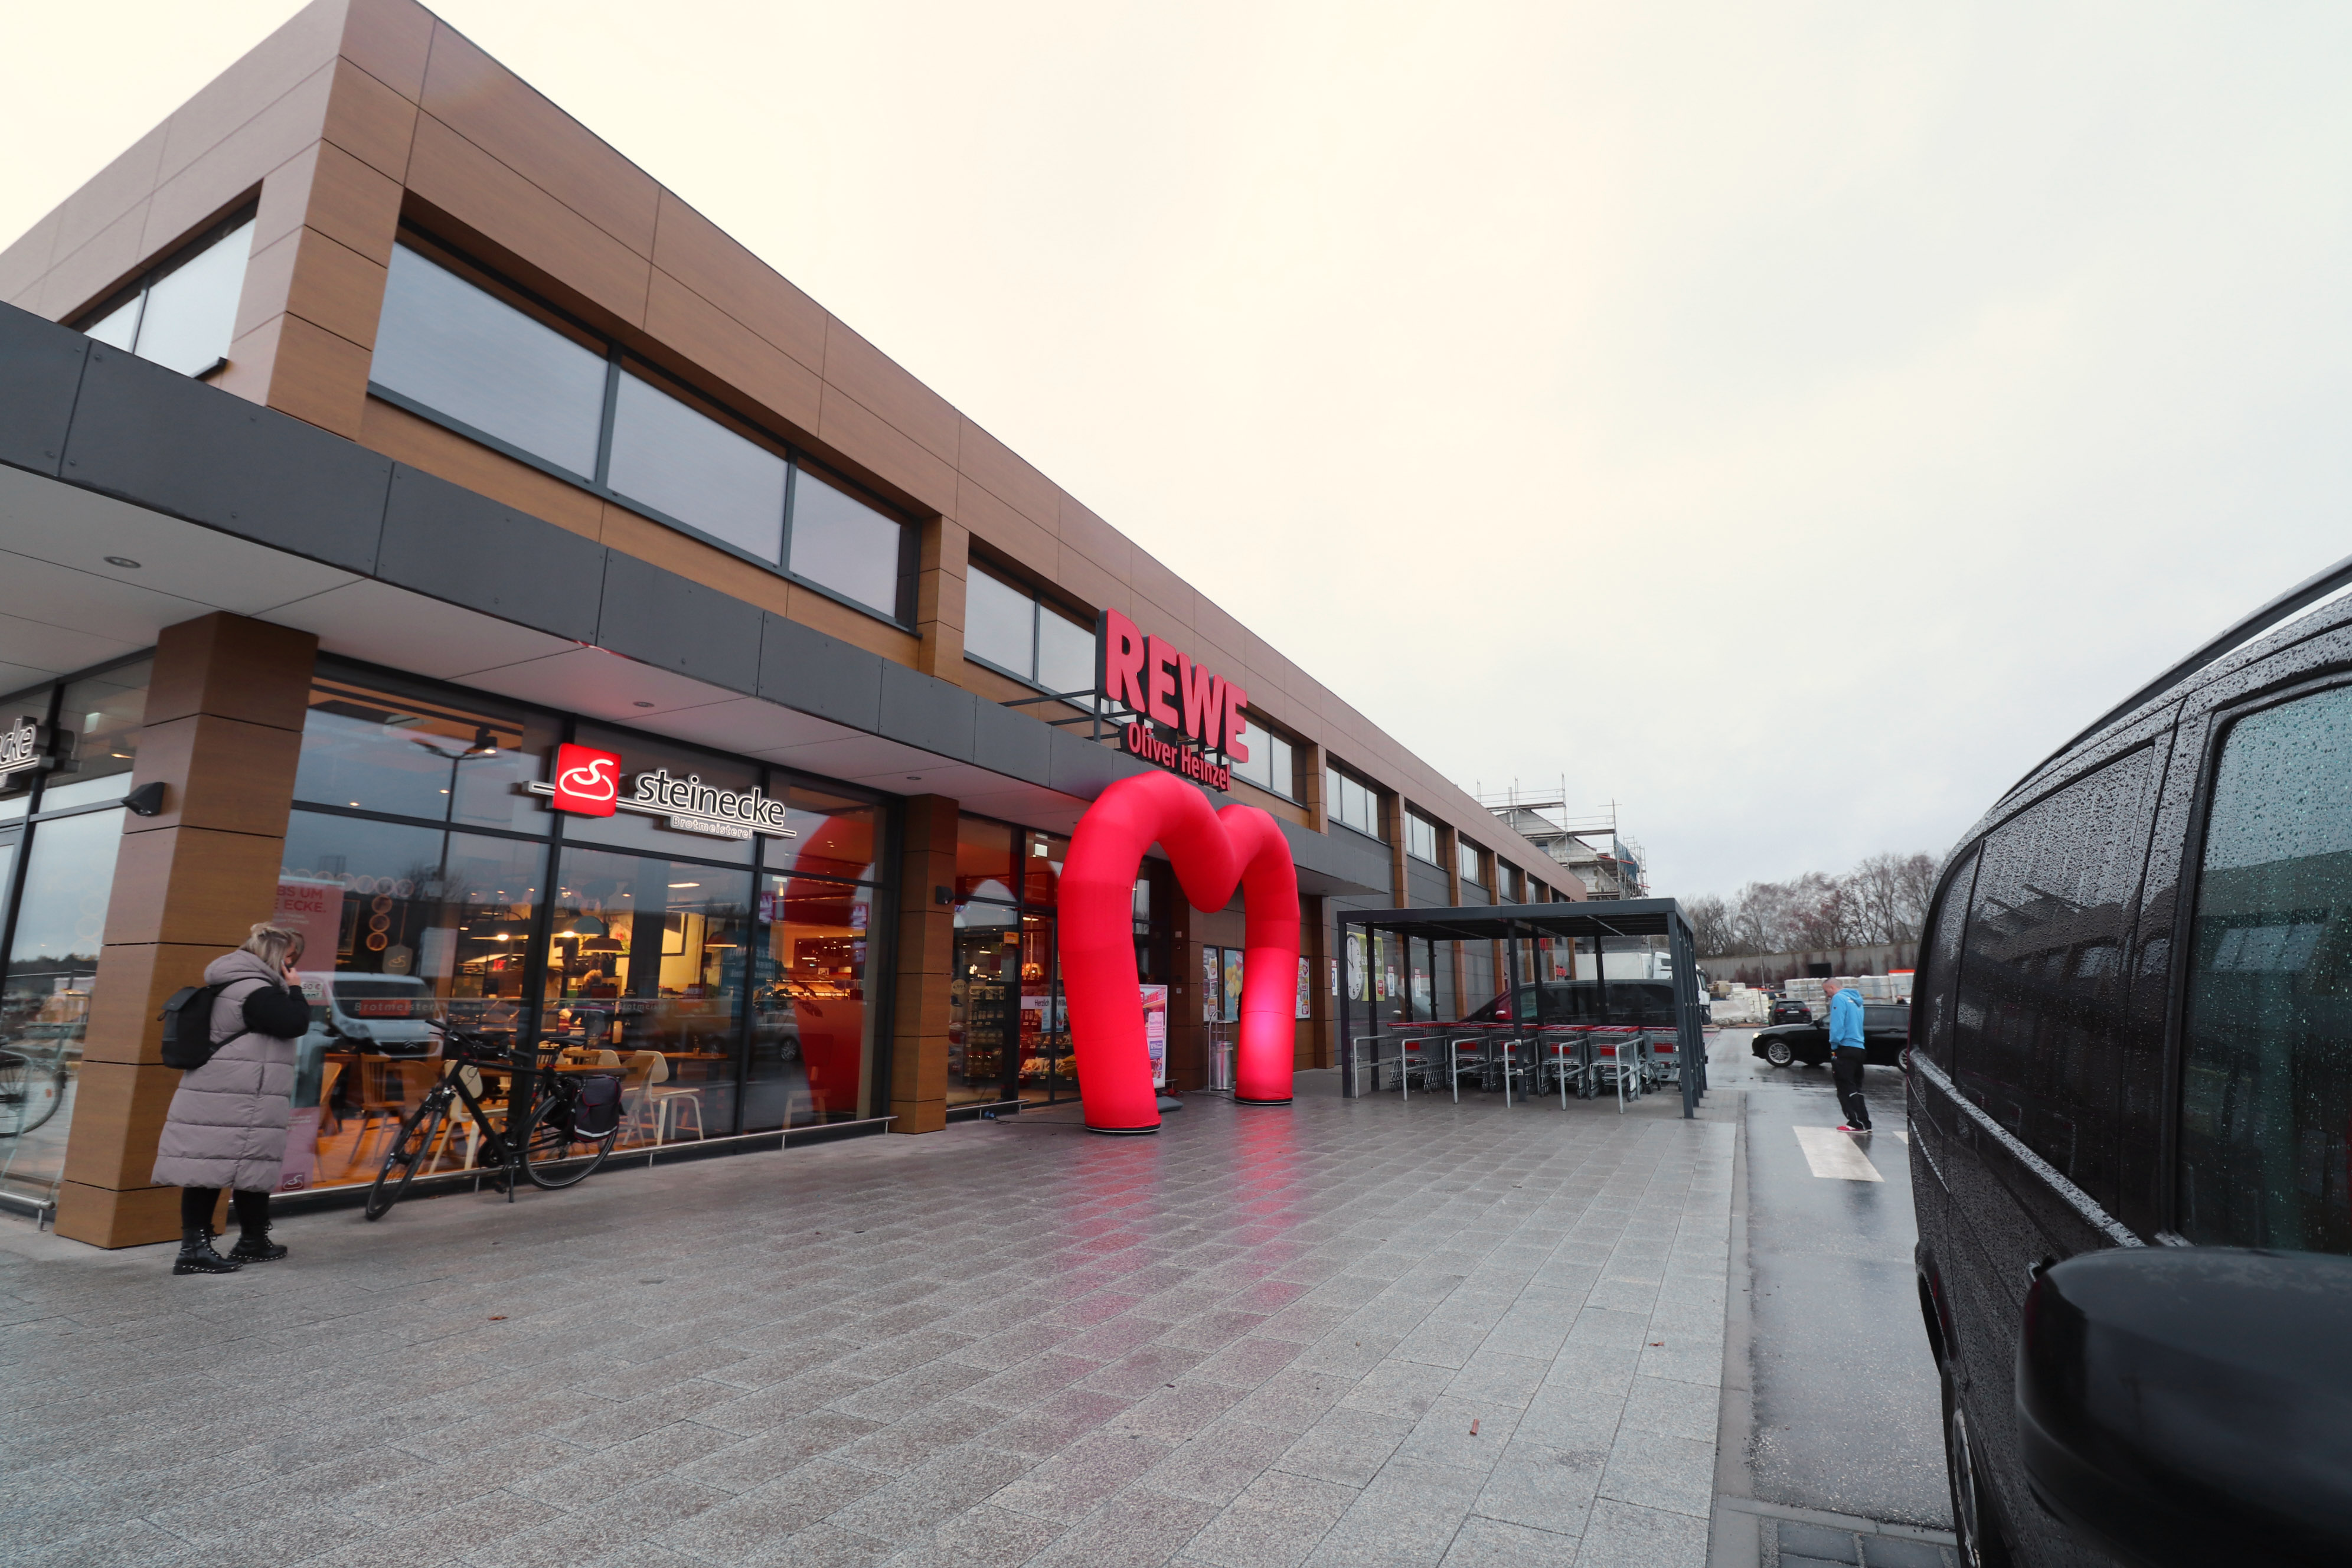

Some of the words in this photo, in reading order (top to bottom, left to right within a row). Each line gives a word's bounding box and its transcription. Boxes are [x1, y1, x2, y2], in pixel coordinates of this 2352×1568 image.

[1105, 607, 1249, 763] REWE
[0, 718, 37, 764] cke
[1127, 721, 1178, 768] Oliver
[1181, 744, 1231, 792] Heinzel
[636, 769, 786, 827] steinecke
[672, 816, 753, 839] Brotmeisterei
[277, 886, 295, 897] BS
[300, 887, 324, 899] UM
[284, 899, 326, 913] ECKE.
